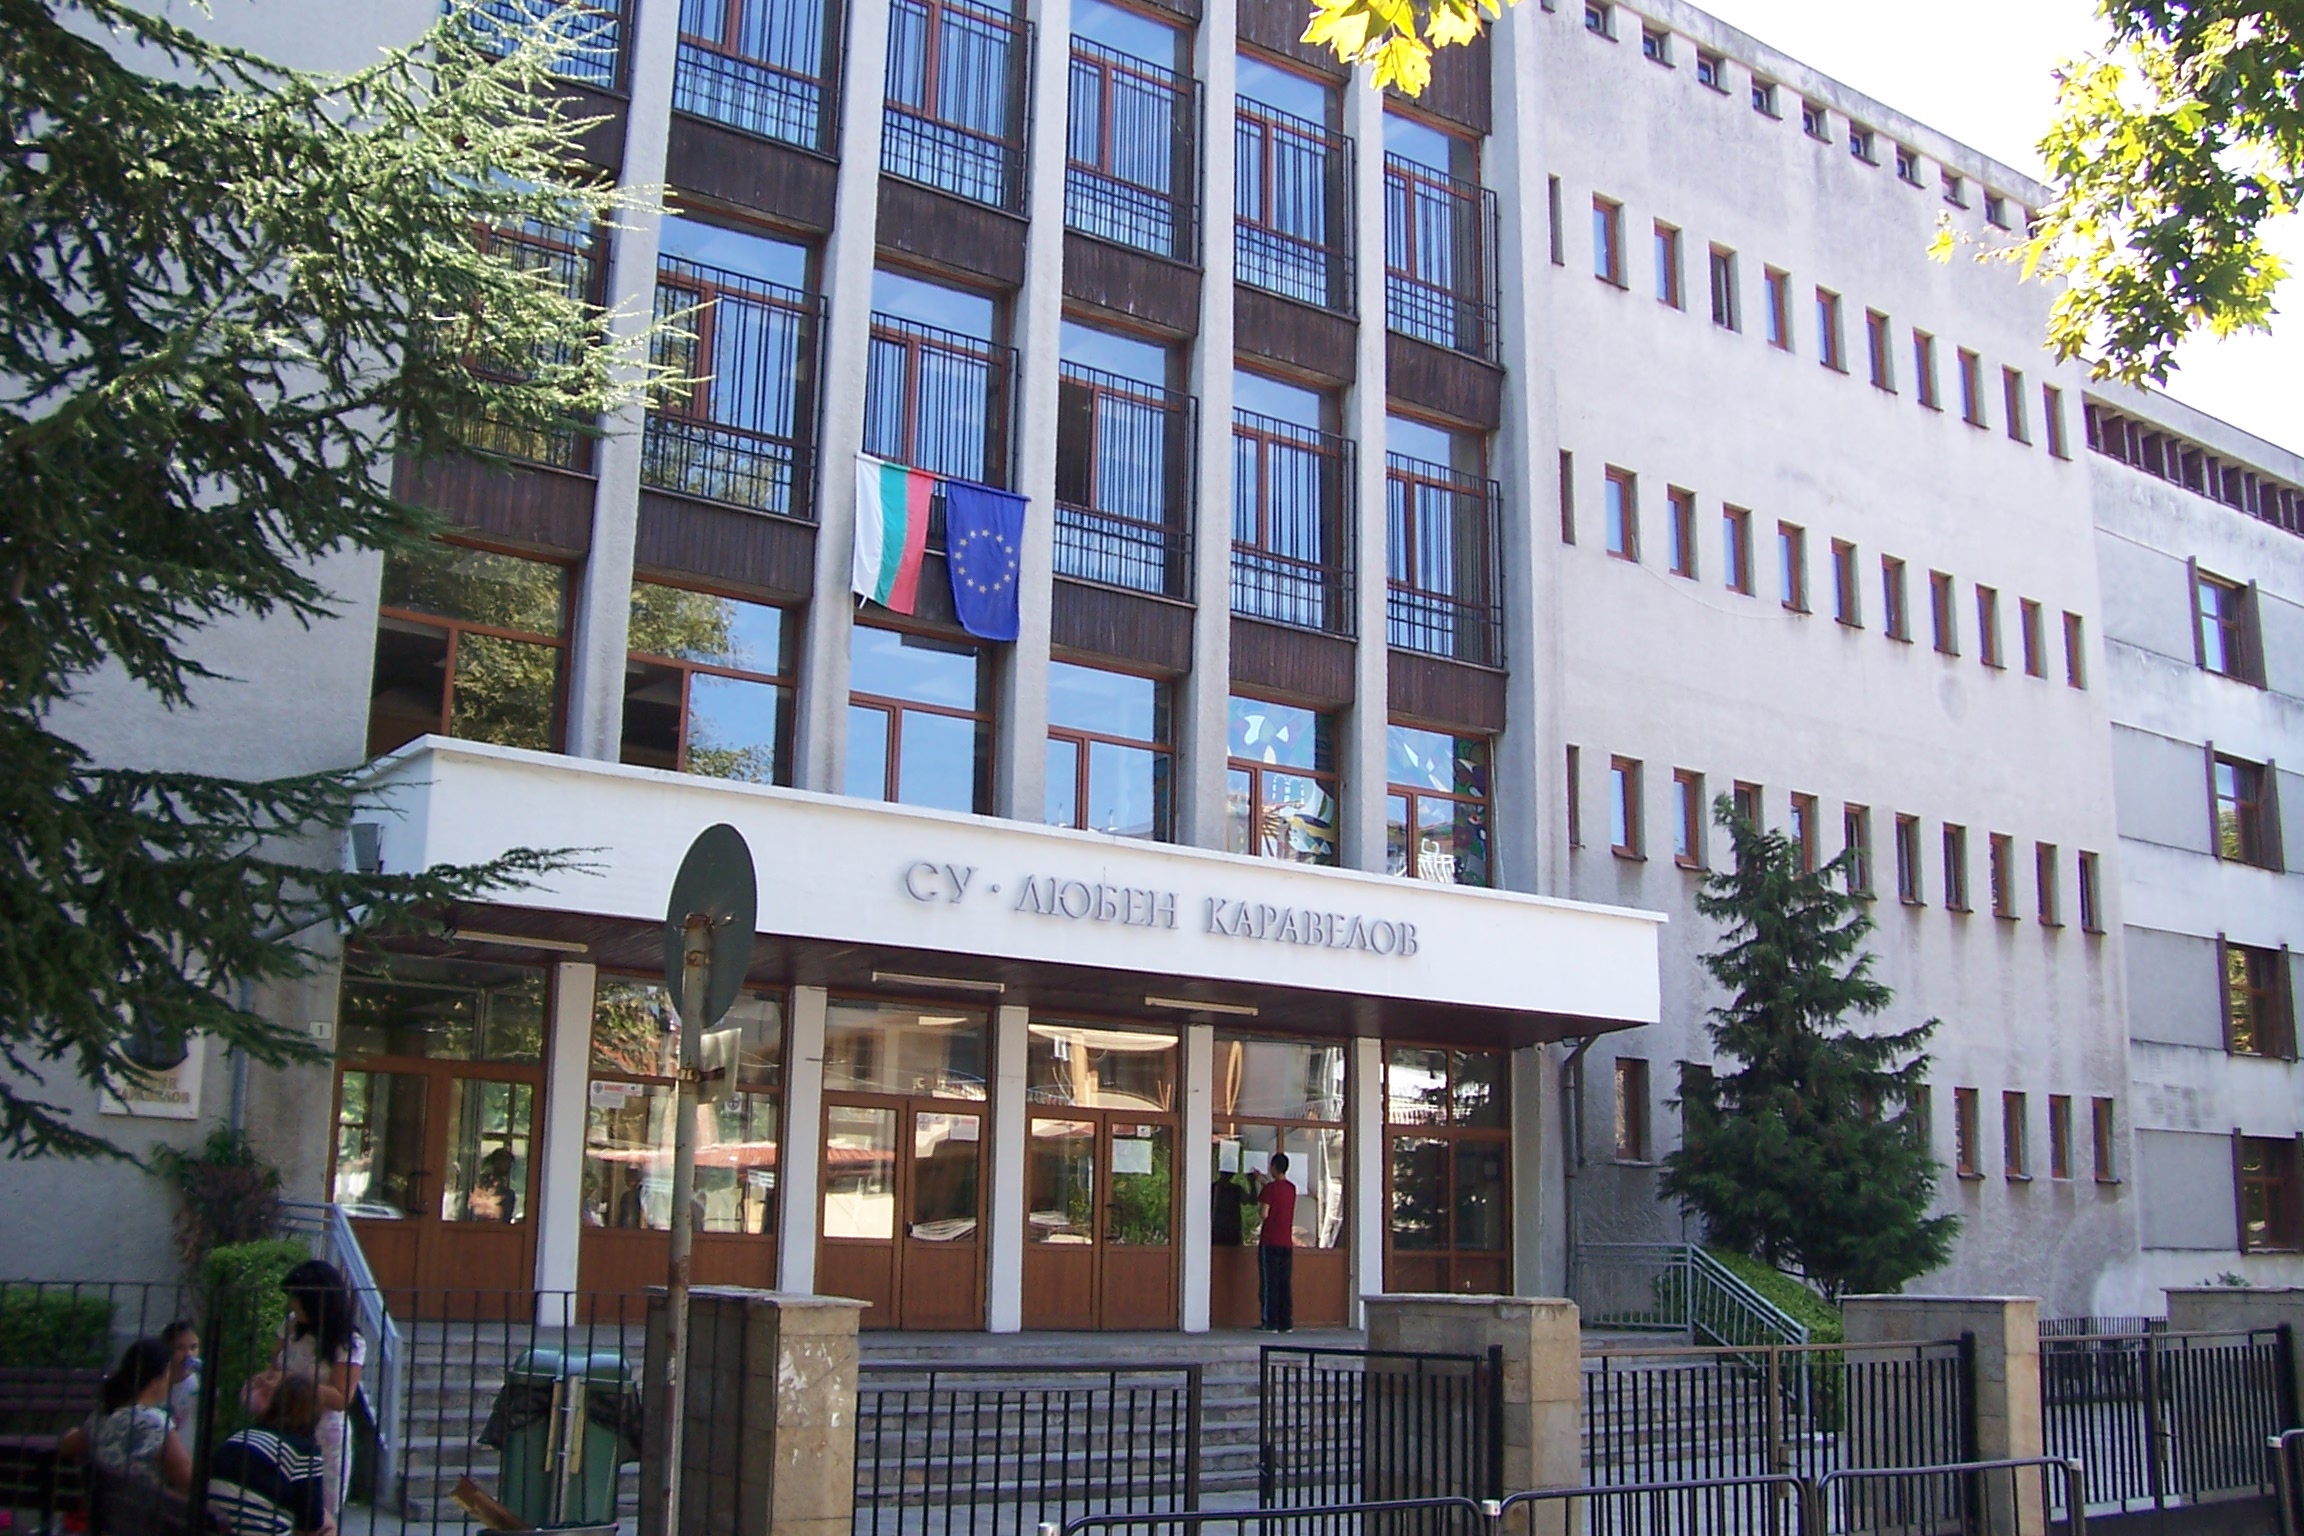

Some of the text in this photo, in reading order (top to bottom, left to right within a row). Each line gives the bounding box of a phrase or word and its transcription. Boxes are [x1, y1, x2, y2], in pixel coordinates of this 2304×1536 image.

[905, 862, 1419, 956] СУ ЛЮБЕН КАРАВЕЛОВ
